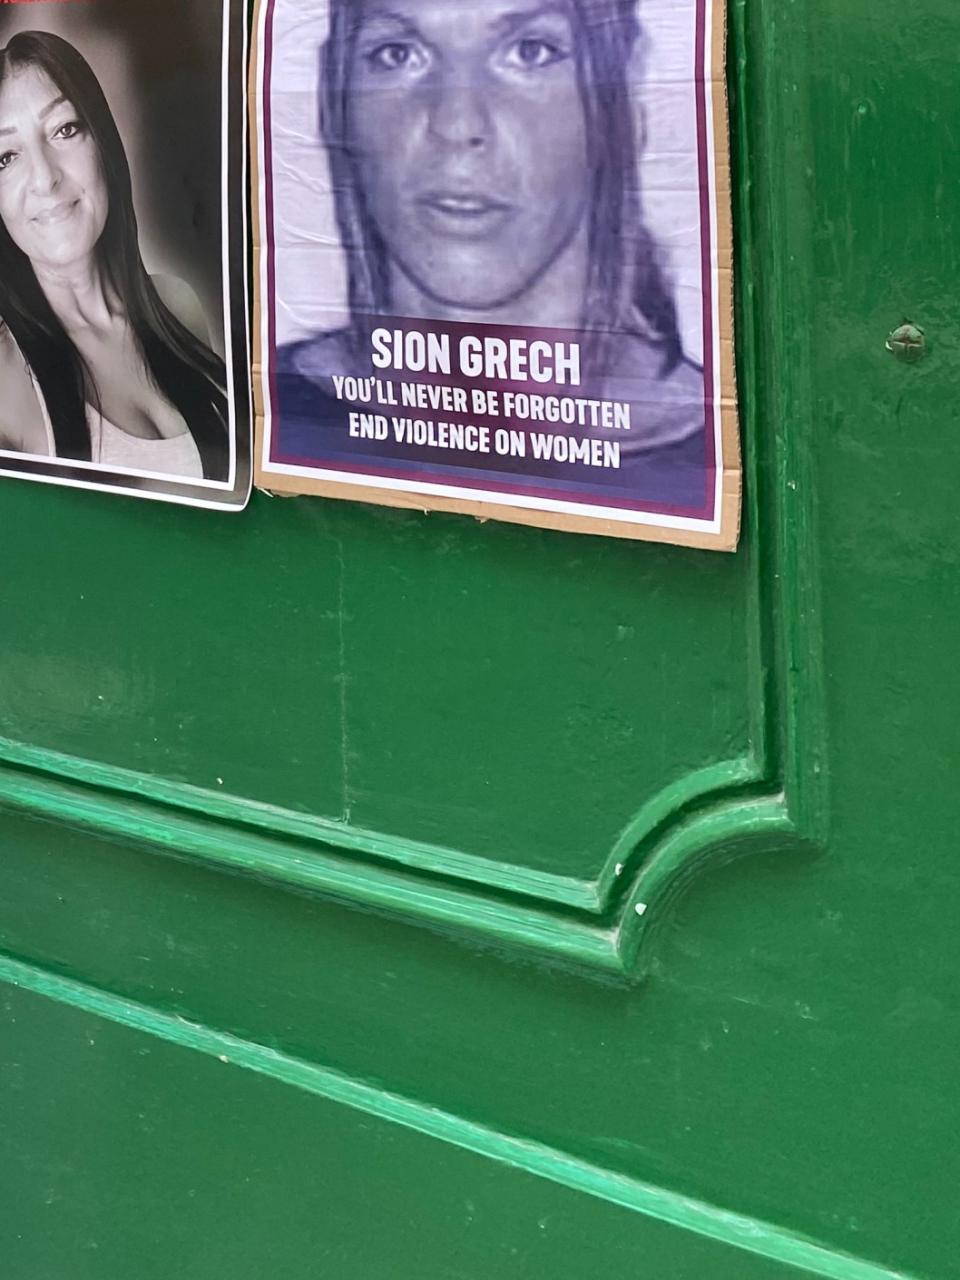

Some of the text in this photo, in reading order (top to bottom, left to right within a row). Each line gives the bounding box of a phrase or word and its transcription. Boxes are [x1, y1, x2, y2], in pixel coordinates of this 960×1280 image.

[371, 328, 581, 385] SION GRECH
[332, 375, 630, 430] YOU’LL NEVER BE FORGOTTEN
[349, 412, 620, 469] END VIOLENCE ON WOMEN
